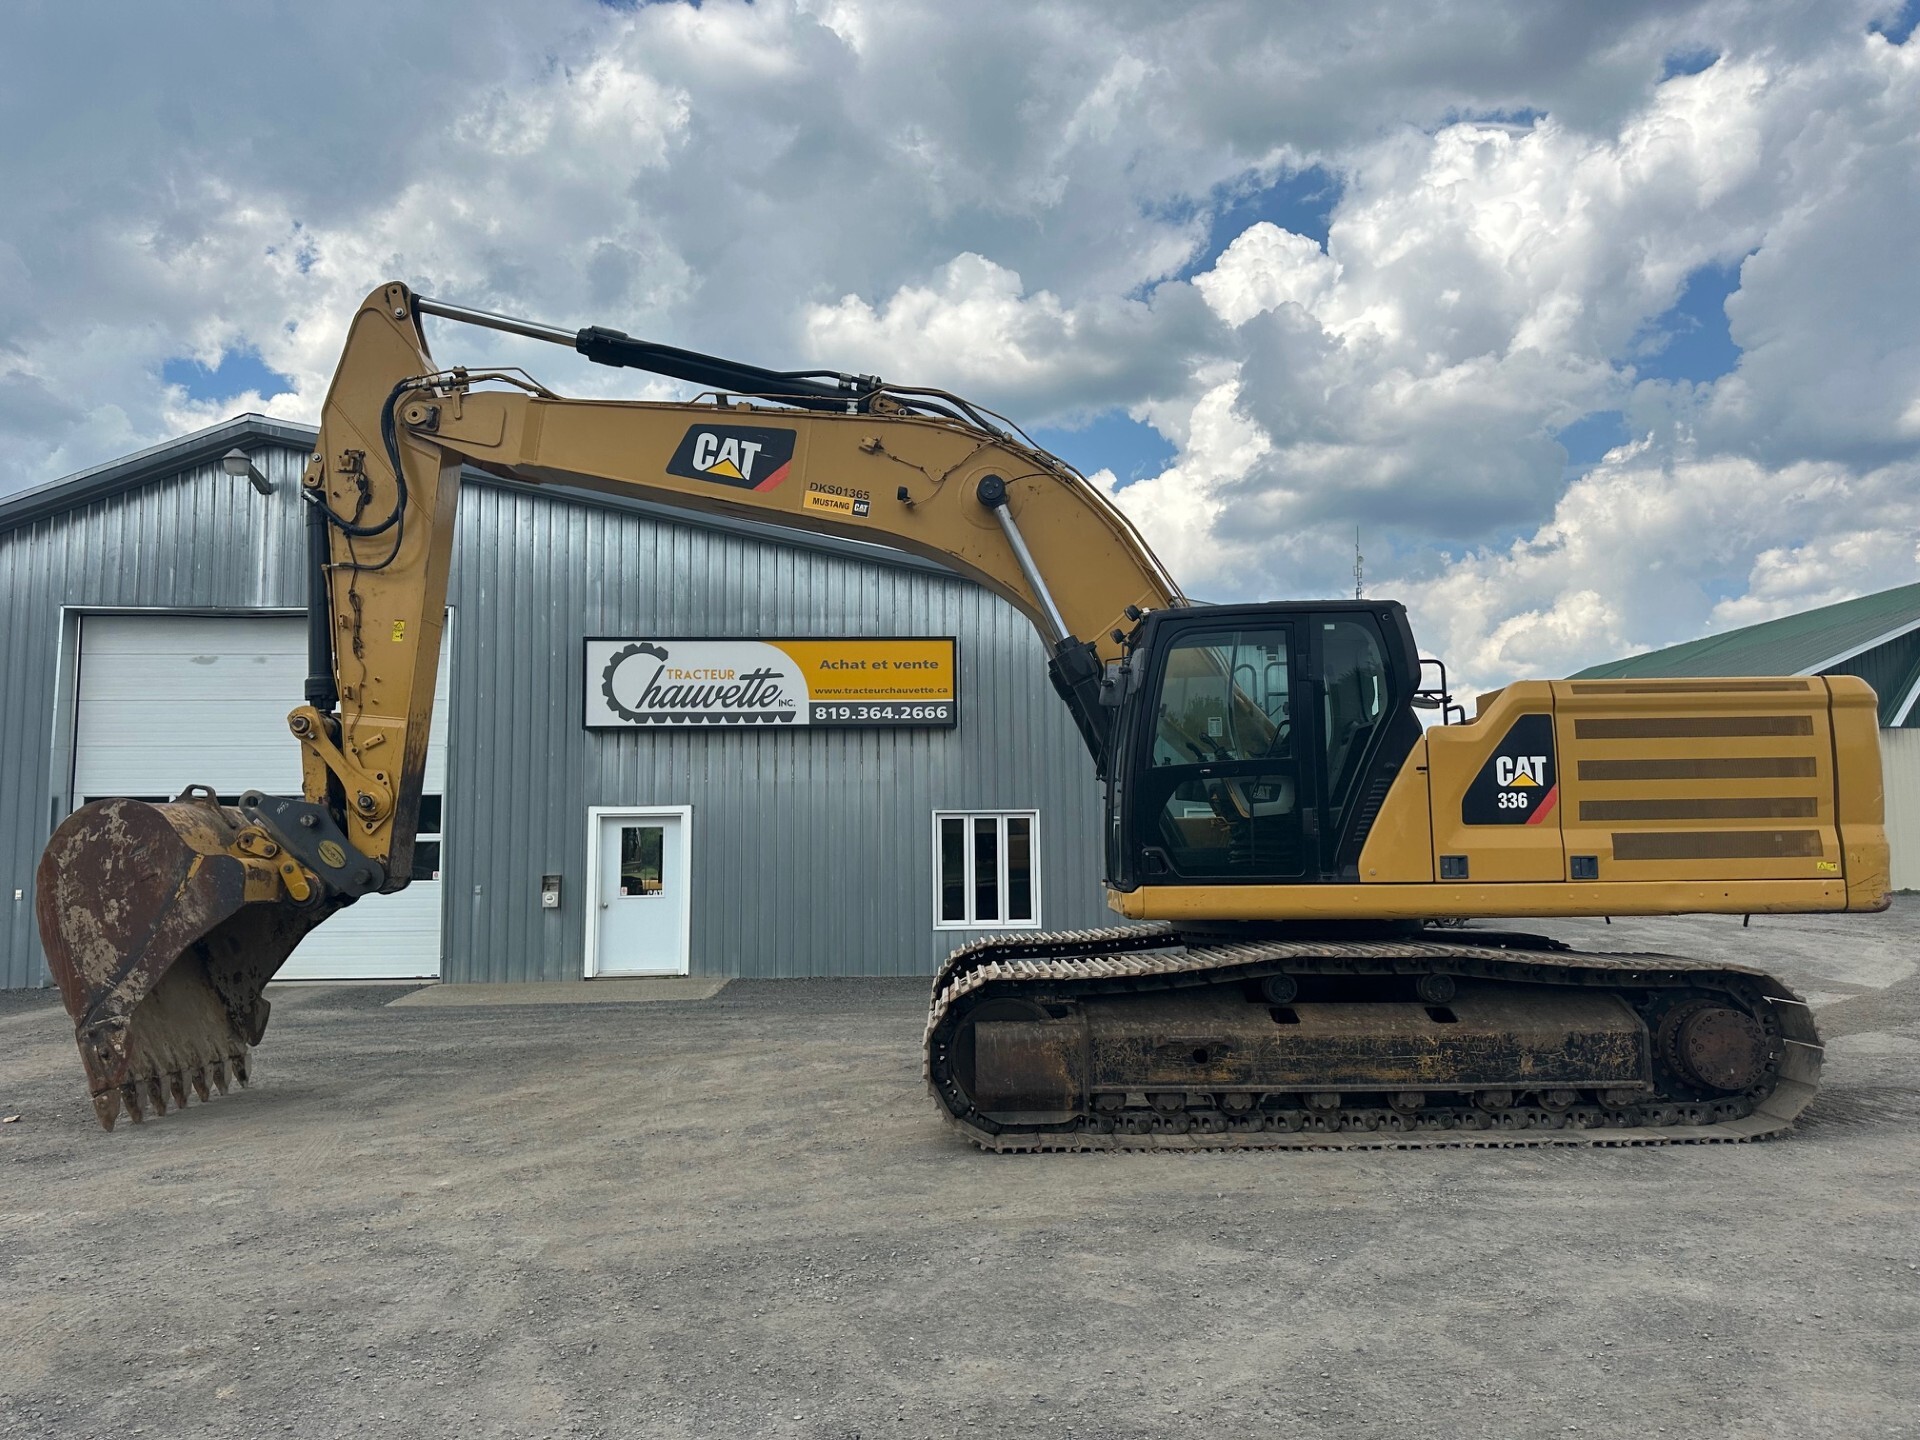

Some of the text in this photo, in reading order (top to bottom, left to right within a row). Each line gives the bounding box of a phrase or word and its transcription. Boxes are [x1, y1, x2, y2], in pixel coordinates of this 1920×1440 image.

[692, 432, 762, 481] CAT
[810, 482, 870, 500] DKS01365
[812, 497, 868, 513] MUSTANG CAT
[820, 660, 939, 670] Achat et vente
[667, 669, 735, 680] TRACTEUR
[778, 699, 796, 707] INC.
[815, 706, 948, 720] 819.364.2666
[1496, 756, 1547, 787] CAT
[1498, 792, 1528, 809] 336
